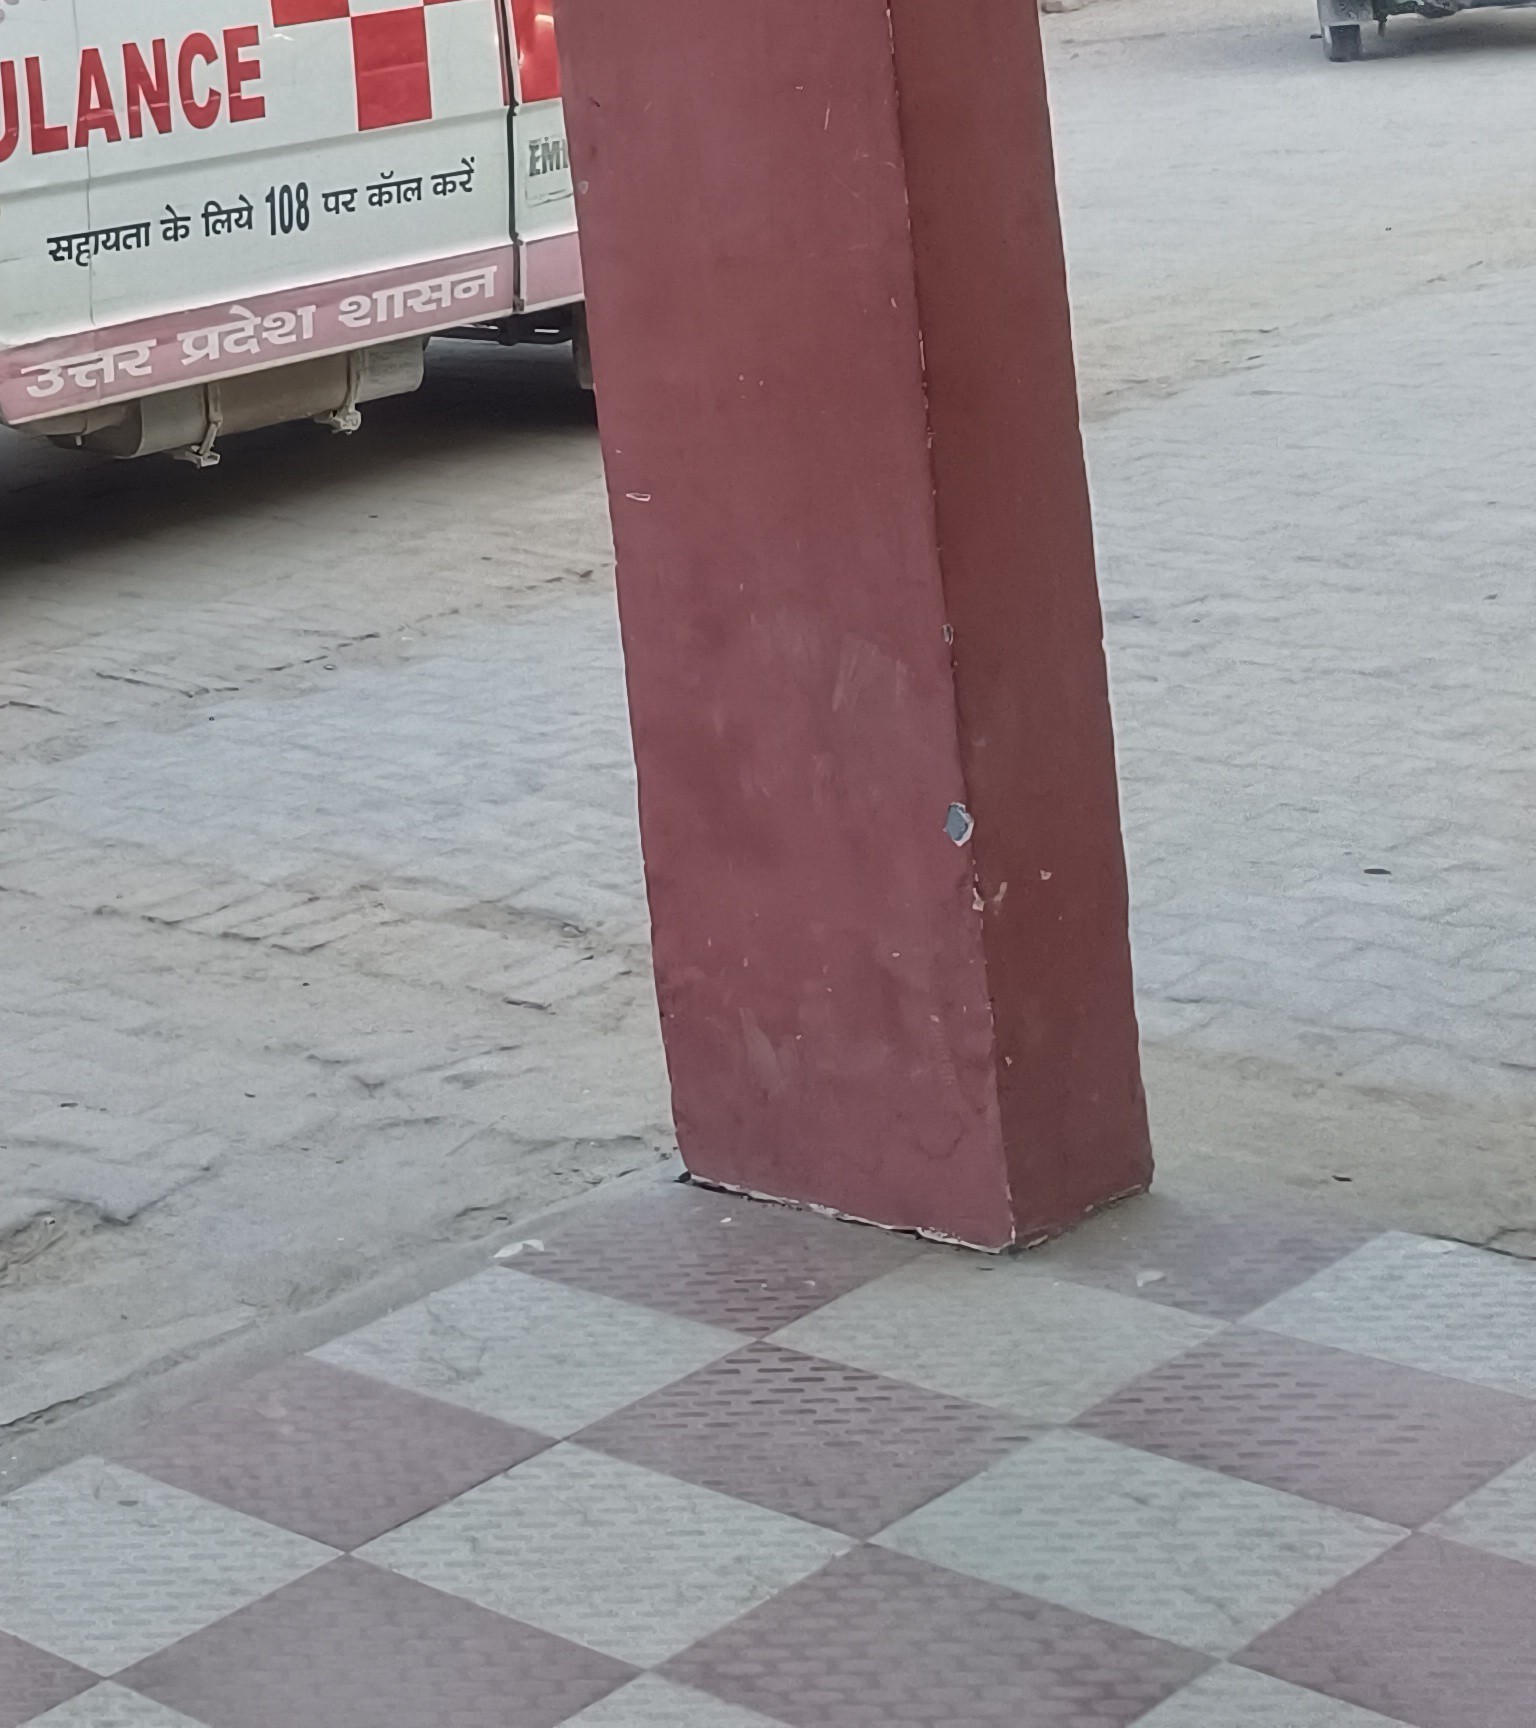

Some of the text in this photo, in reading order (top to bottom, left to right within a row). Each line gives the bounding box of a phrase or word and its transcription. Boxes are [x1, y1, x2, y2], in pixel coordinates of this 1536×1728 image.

[46, 156, 477, 266] सहायता के लिये 108 पर कॉल करें
[21, 265, 499, 400] उत्तर प्रदेश शासन
